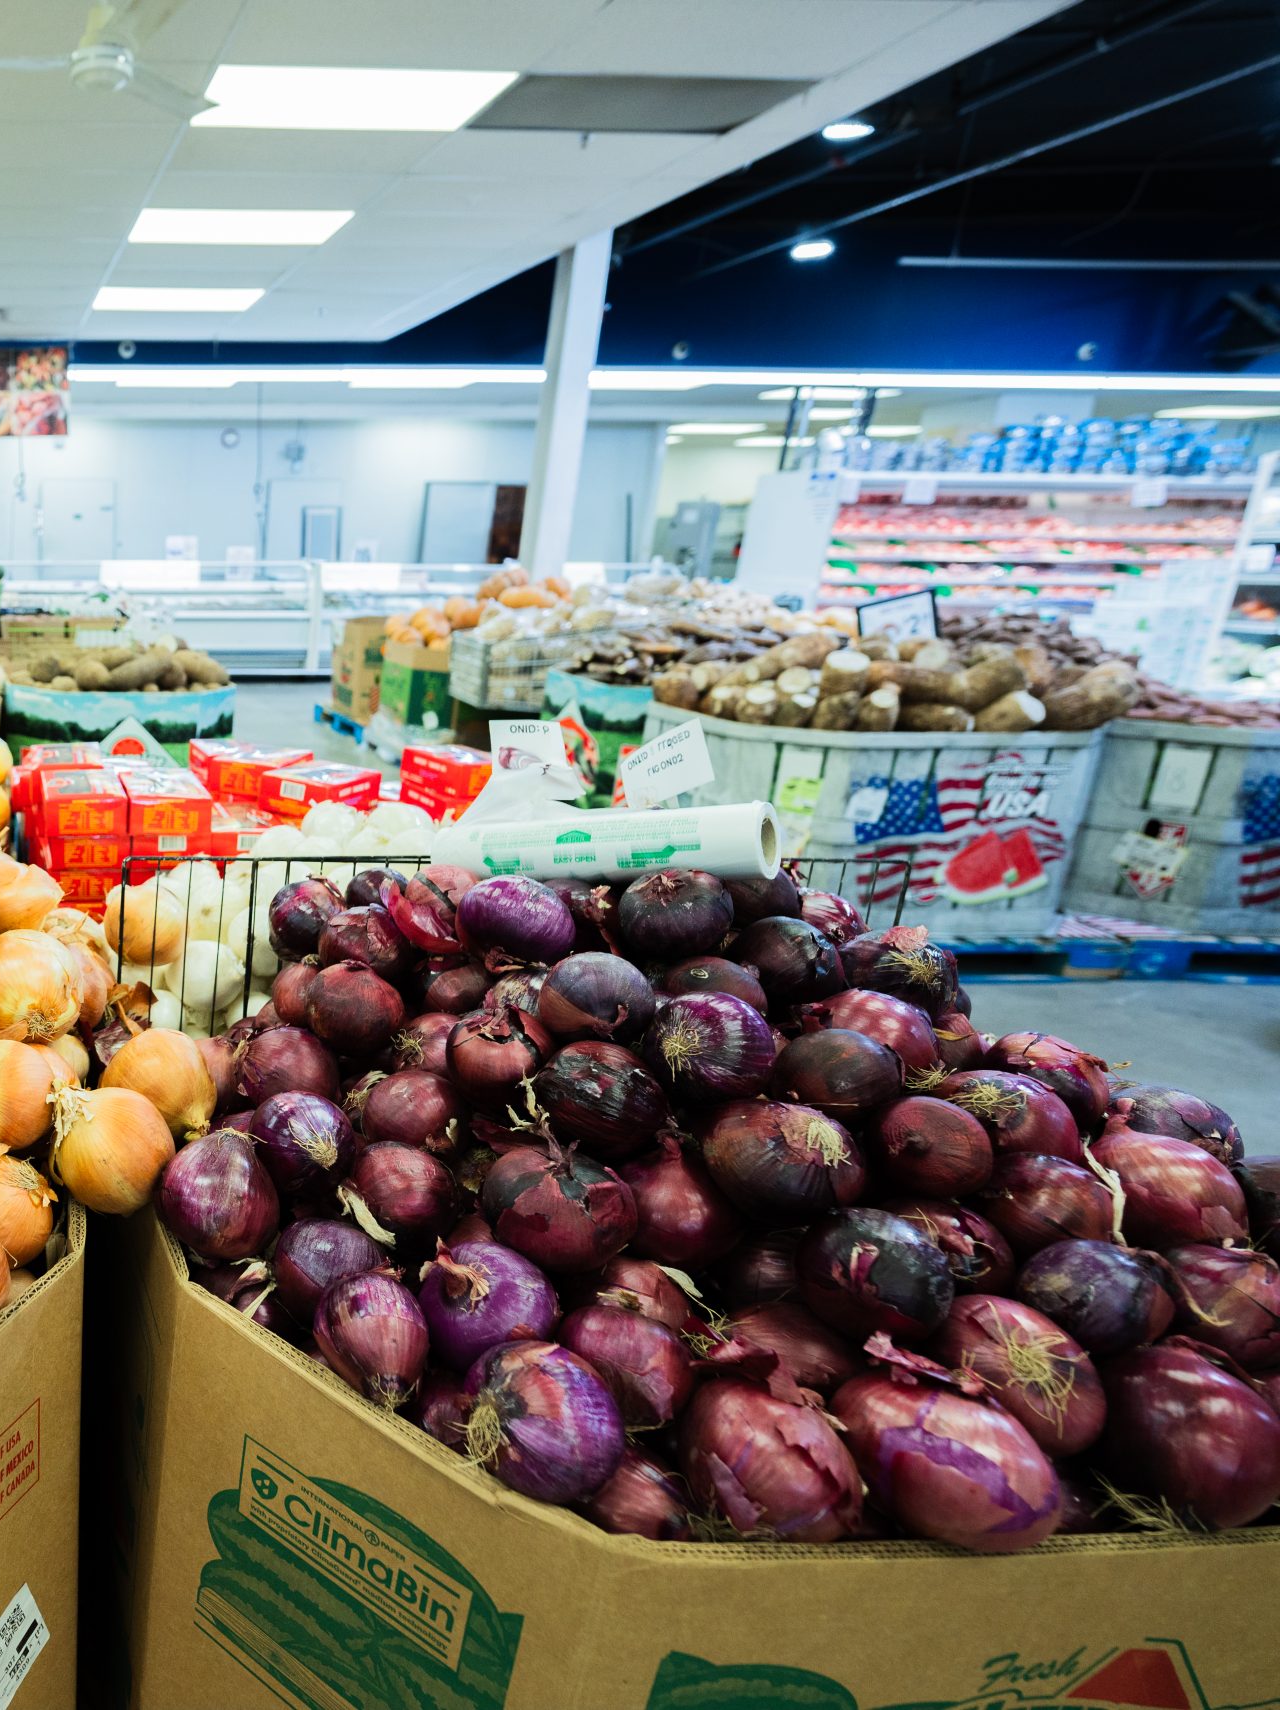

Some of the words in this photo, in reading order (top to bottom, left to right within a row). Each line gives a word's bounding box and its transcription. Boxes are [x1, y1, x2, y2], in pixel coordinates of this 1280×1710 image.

[986, 791, 1049, 818] USA
[553, 855, 573, 865] EASY
[574, 854, 597, 863] OPEN
[5, 1430, 21, 1453] USA
[6, 1440, 34, 1477] MEXICO
[6, 1460, 35, 1497] CANADA
[300, 1485, 365, 1533] INTERNATIONAL
[380, 1540, 406, 1563] PAPER
[250, 1503, 268, 1519] with
[268, 1517, 310, 1551] proprietary
[398, 1611, 448, 1651] technology
[977, 1644, 1089, 1694] Fresh
